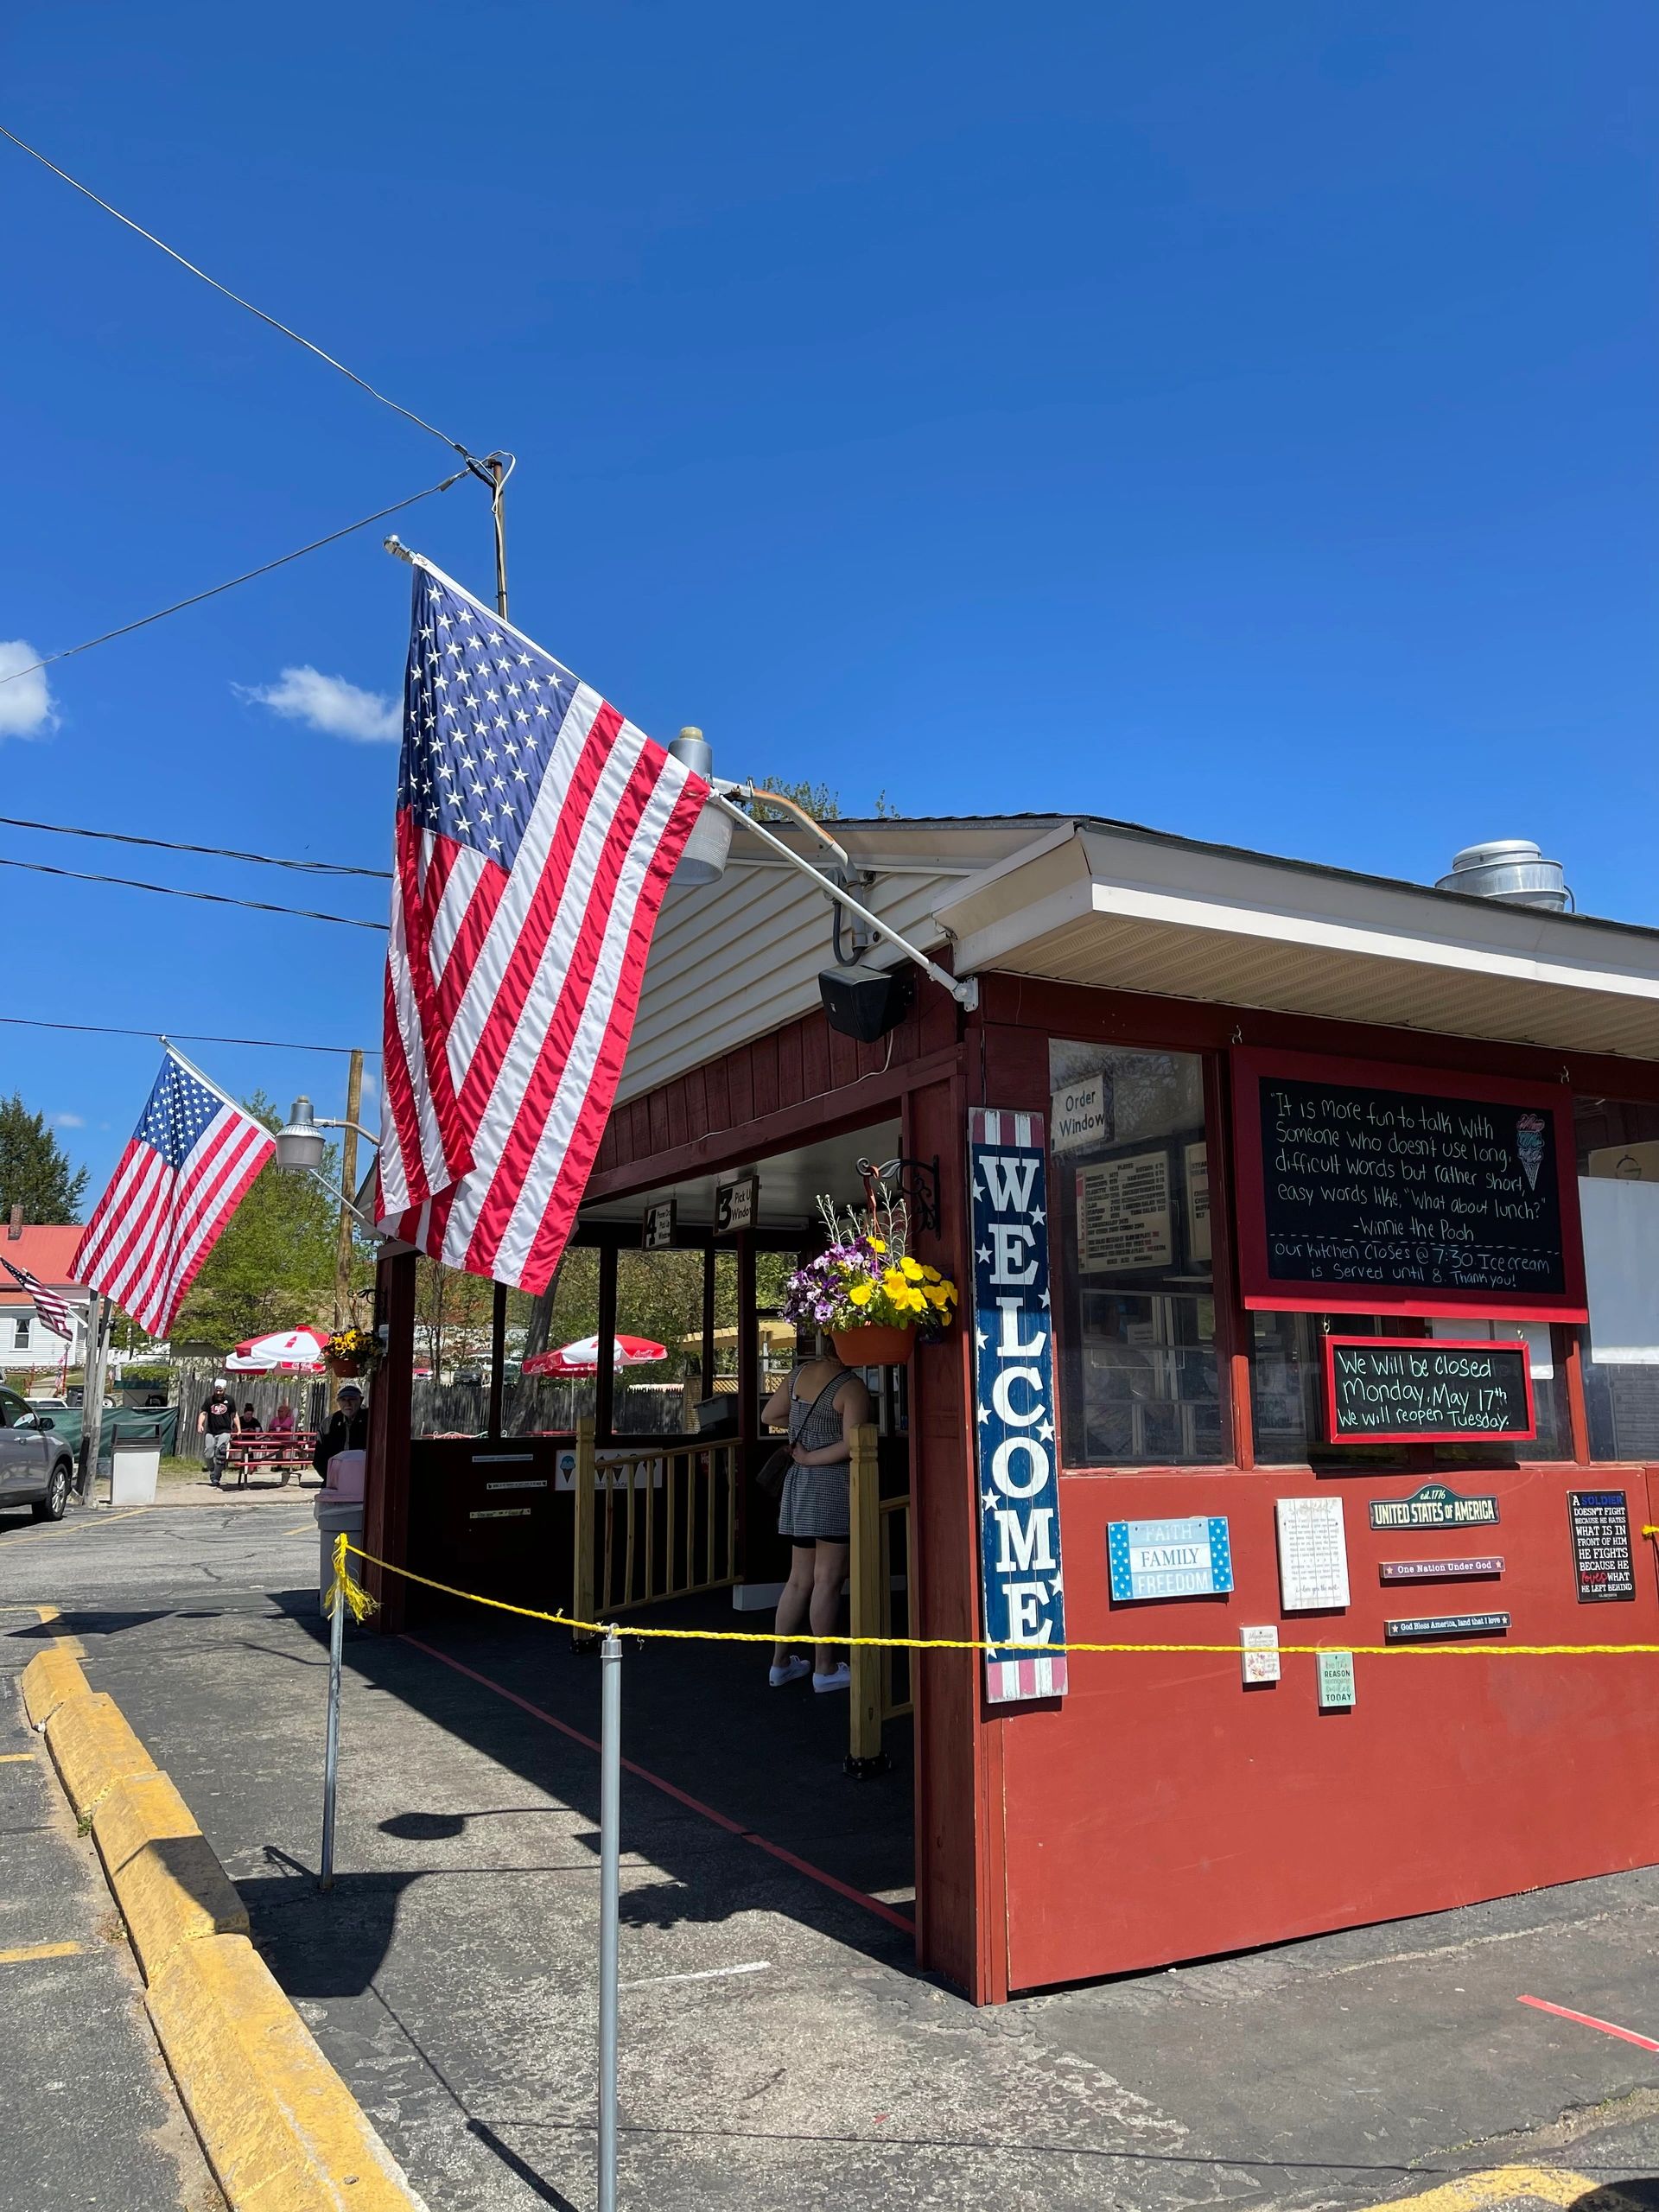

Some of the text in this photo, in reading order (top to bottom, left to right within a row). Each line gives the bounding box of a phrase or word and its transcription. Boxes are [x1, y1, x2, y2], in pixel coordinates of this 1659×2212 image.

[1065, 1090, 1096, 1112] Order
[1059, 1113, 1105, 1137] Window
[1300, 1102, 1316, 1119] is
[1366, 1102, 1394, 1126] fun
[1397, 1105, 1414, 1128] to
[1418, 1106, 1452, 1135] talk
[1388, 1131, 1437, 1158] doesn't
[1442, 1141, 1468, 1160] use
[1473, 1143, 1512, 1173] long,
[1275, 1147, 1341, 1175] difficult
[1346, 1158, 1395, 1178] words
[1401, 1160, 1427, 1180] but
[1434, 1165, 1477, 1186] rather
[718, 1188, 733, 1230] 3
[734, 1191, 746, 1204] Pick
[1277, 1184, 1313, 1206] easy
[1320, 1184, 1368, 1205] words
[1451, 1197, 1488, 1214] about
[648, 1210, 657, 1246] 4
[1409, 1217, 1435, 1238] the
[1440, 1218, 1474, 1242] Pooh
[1416, 1247, 1429, 1264] @
[1312, 1262, 1323, 1279] is
[1393, 1266, 1424, 1281] until
[1449, 1270, 1488, 1285] Thank
[1490, 1274, 1517, 1288] you!
[1338, 1351, 1367, 1375] We
[1410, 1354, 1429, 1377] be
[979, 1155, 1057, 1651] WELCOME
[1433, 1382, 1469, 1415] May
[1479, 1387, 1507, 1412] 17th
[1338, 1405, 1510, 1432] We will reopen Tuesday.
[1573, 1495, 1624, 1506] A SOLDIER
[1573, 1507, 1626, 1516] DOESN'T FIGHT
[1374, 1500, 1495, 1525] UNITED STATES OF AMERICA
[1575, 1525, 1626, 1536] WHAT IS IN
[1577, 1536, 1628, 1547] FRONT OF HIM
[1141, 1548, 1199, 1567] FAMILY
[1578, 1548, 1629, 1560] HE FIGHTS
[1417, 1563, 1446, 1573] Nation
[1447, 1562, 1474, 1572] Under
[1580, 1560, 1630, 1572] BECAUSE HE
[1138, 1572, 1209, 1595] FREEDOM
[1581, 1571, 1630, 1585] loves WHAT
[1607, 1583, 1632, 1592] BEHIND
[1401, 1623, 1414, 1631] God
[1430, 1619, 1458, 1629] America,
